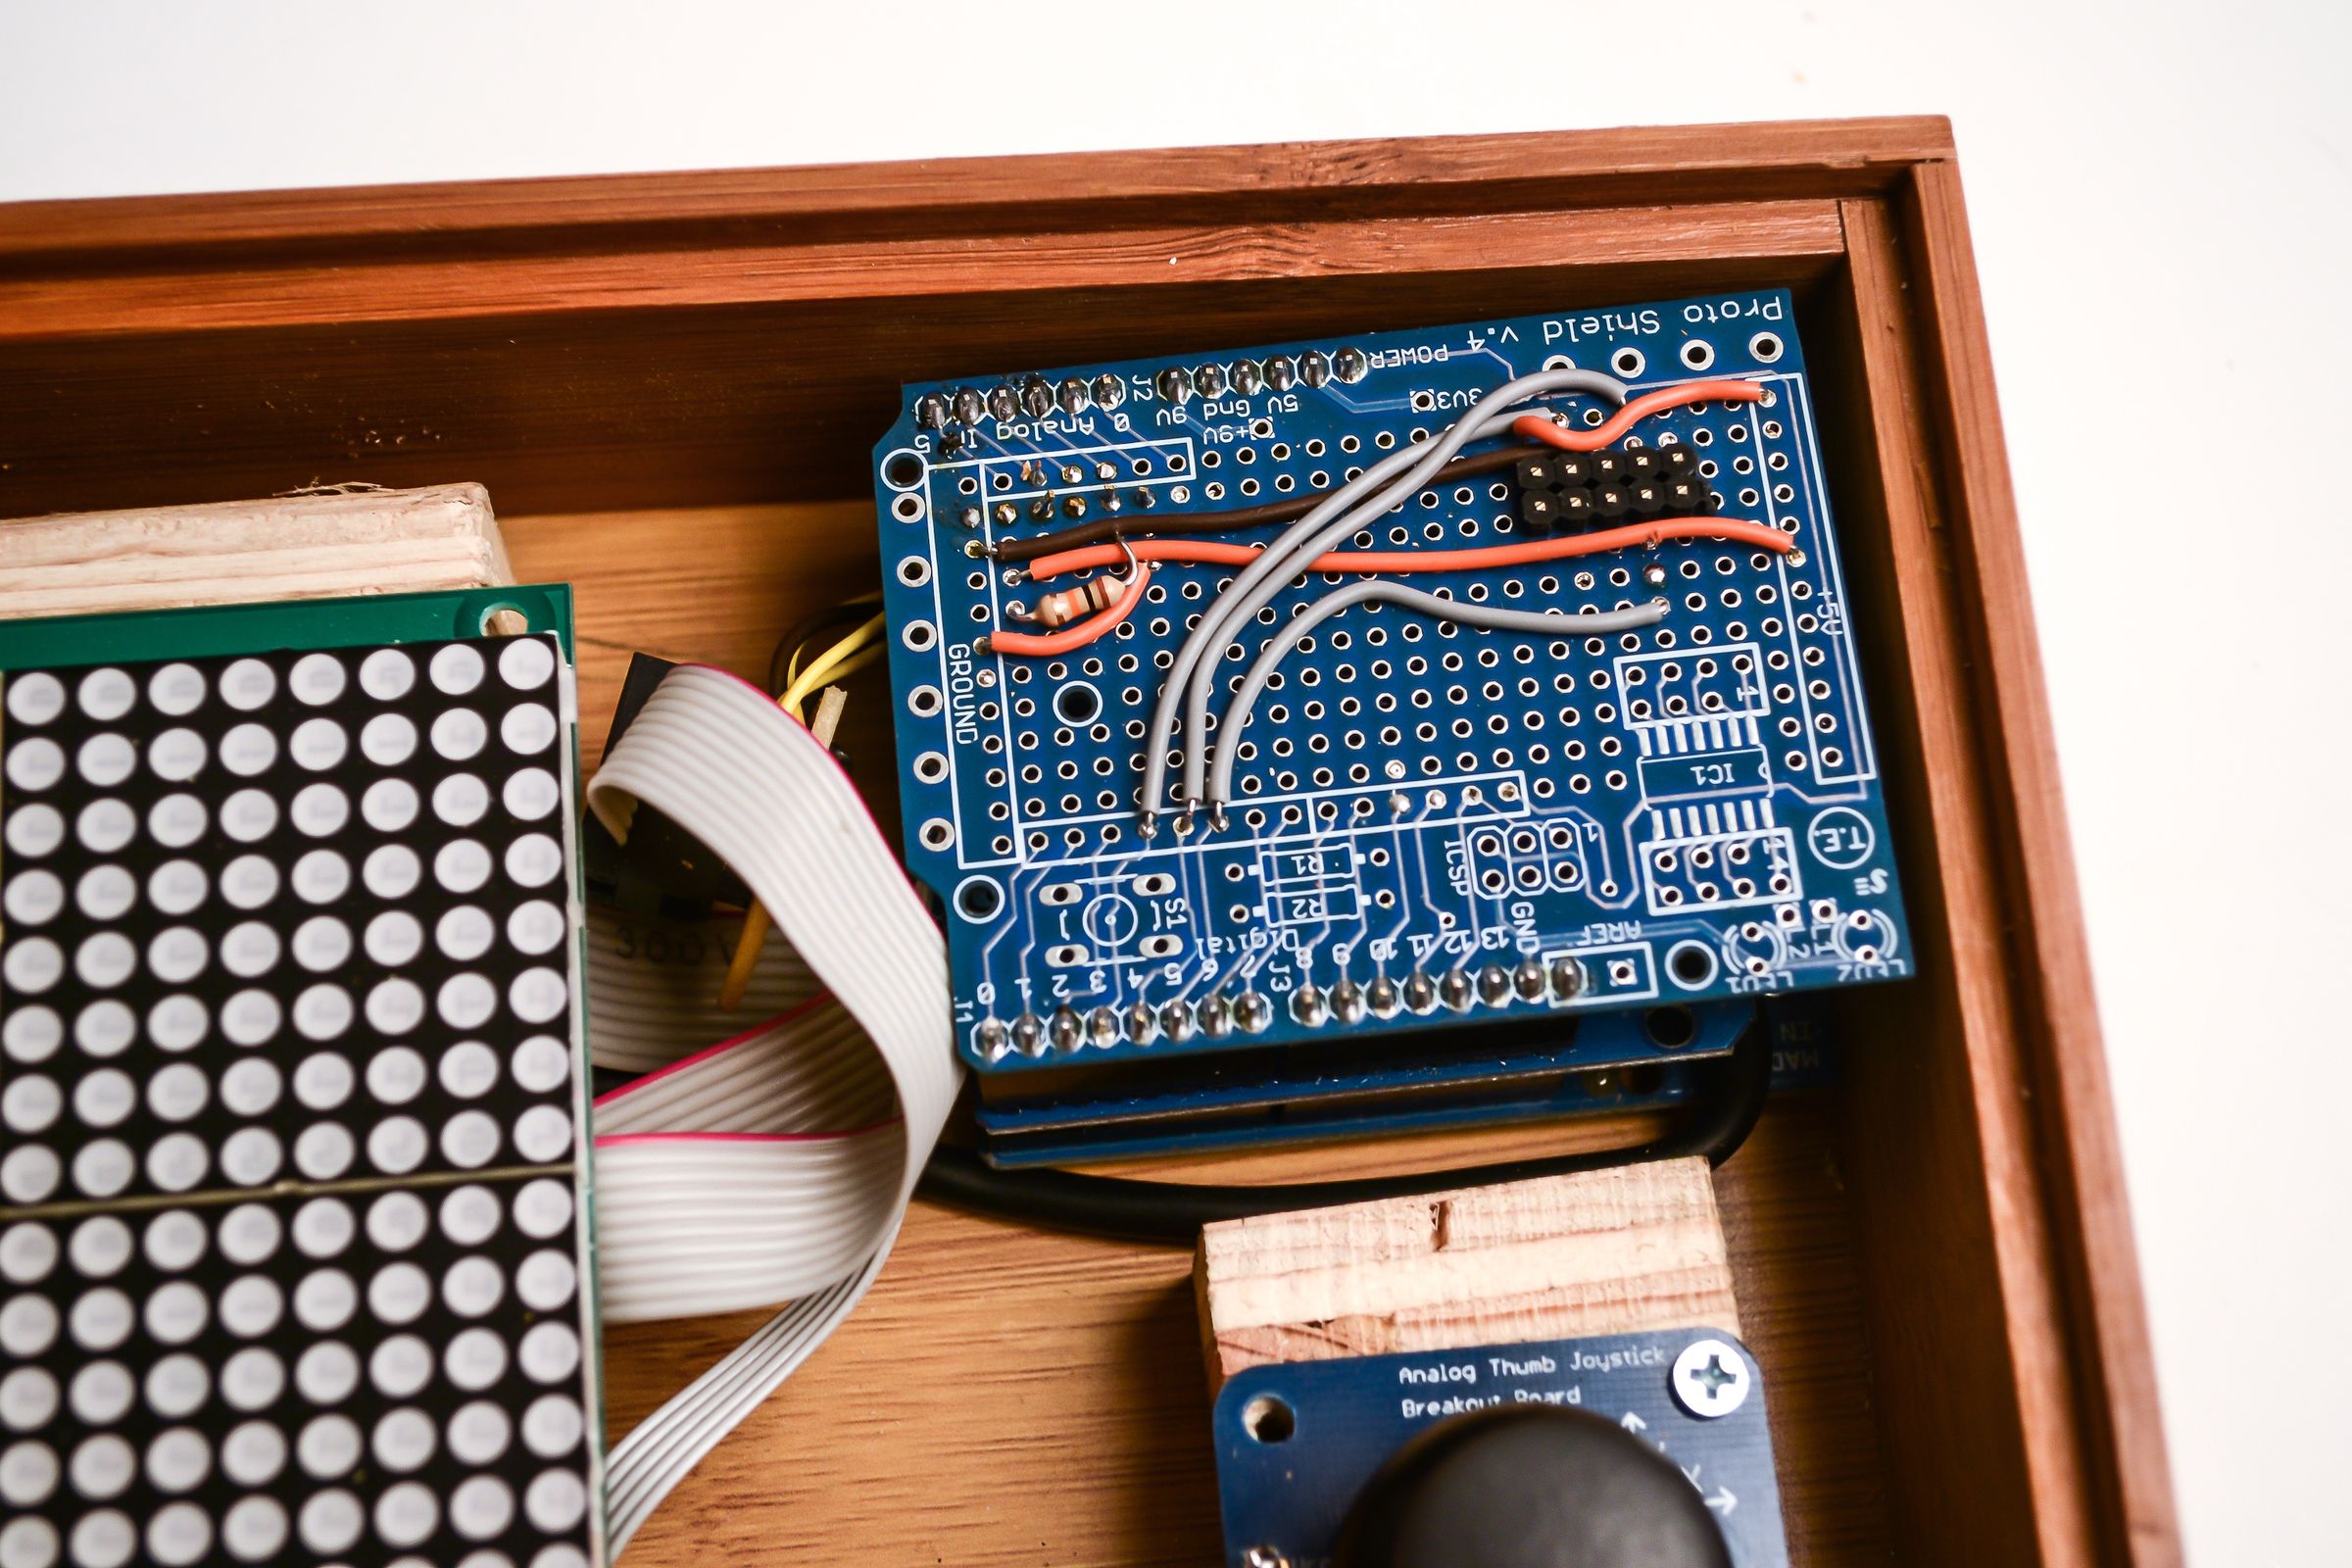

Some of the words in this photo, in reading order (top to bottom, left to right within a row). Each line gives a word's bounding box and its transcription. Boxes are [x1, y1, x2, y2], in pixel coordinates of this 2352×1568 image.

[1683, 296, 1784, 324] Proto
[1466, 325, 1519, 352] v.4
[1543, 309, 1661, 345] Shield
[1369, 343, 1448, 368] POWER
[1131, 373, 1154, 402] J2
[1202, 399, 1250, 420] Gnd
[1267, 393, 1299, 414] 5V
[995, 416, 1096, 442] Analog
[913, 433, 932, 454] 5
[947, 643, 979, 746] GROUND
[1689, 762, 1736, 787] IC1
[1291, 854, 1325, 876] R1
[1443, 839, 1470, 898] ICSP
[1164, 897, 1189, 930] S1
[1291, 898, 1324, 920] R2
[1480, 925, 1511, 952] 13
[1510, 901, 1541, 956] GND
[1576, 919, 1642, 947] AREF
[1196, 926, 1300, 960] Digital
[1405, 933, 1435, 958] 11
[1445, 929, 1472, 955] 12
[1295, 945, 1314, 970] 8
[1051, 973, 1071, 998] 2
[1089, 970, 1107, 994] 3
[1127, 967, 1145, 990] 4
[1163, 961, 1184, 987] 5
[1268, 960, 1293, 993] J3
[1398, 1363, 1477, 1385] Analog
[1489, 1356, 1556, 1379] Thumb
[1569, 1346, 1667, 1373] Joystick
